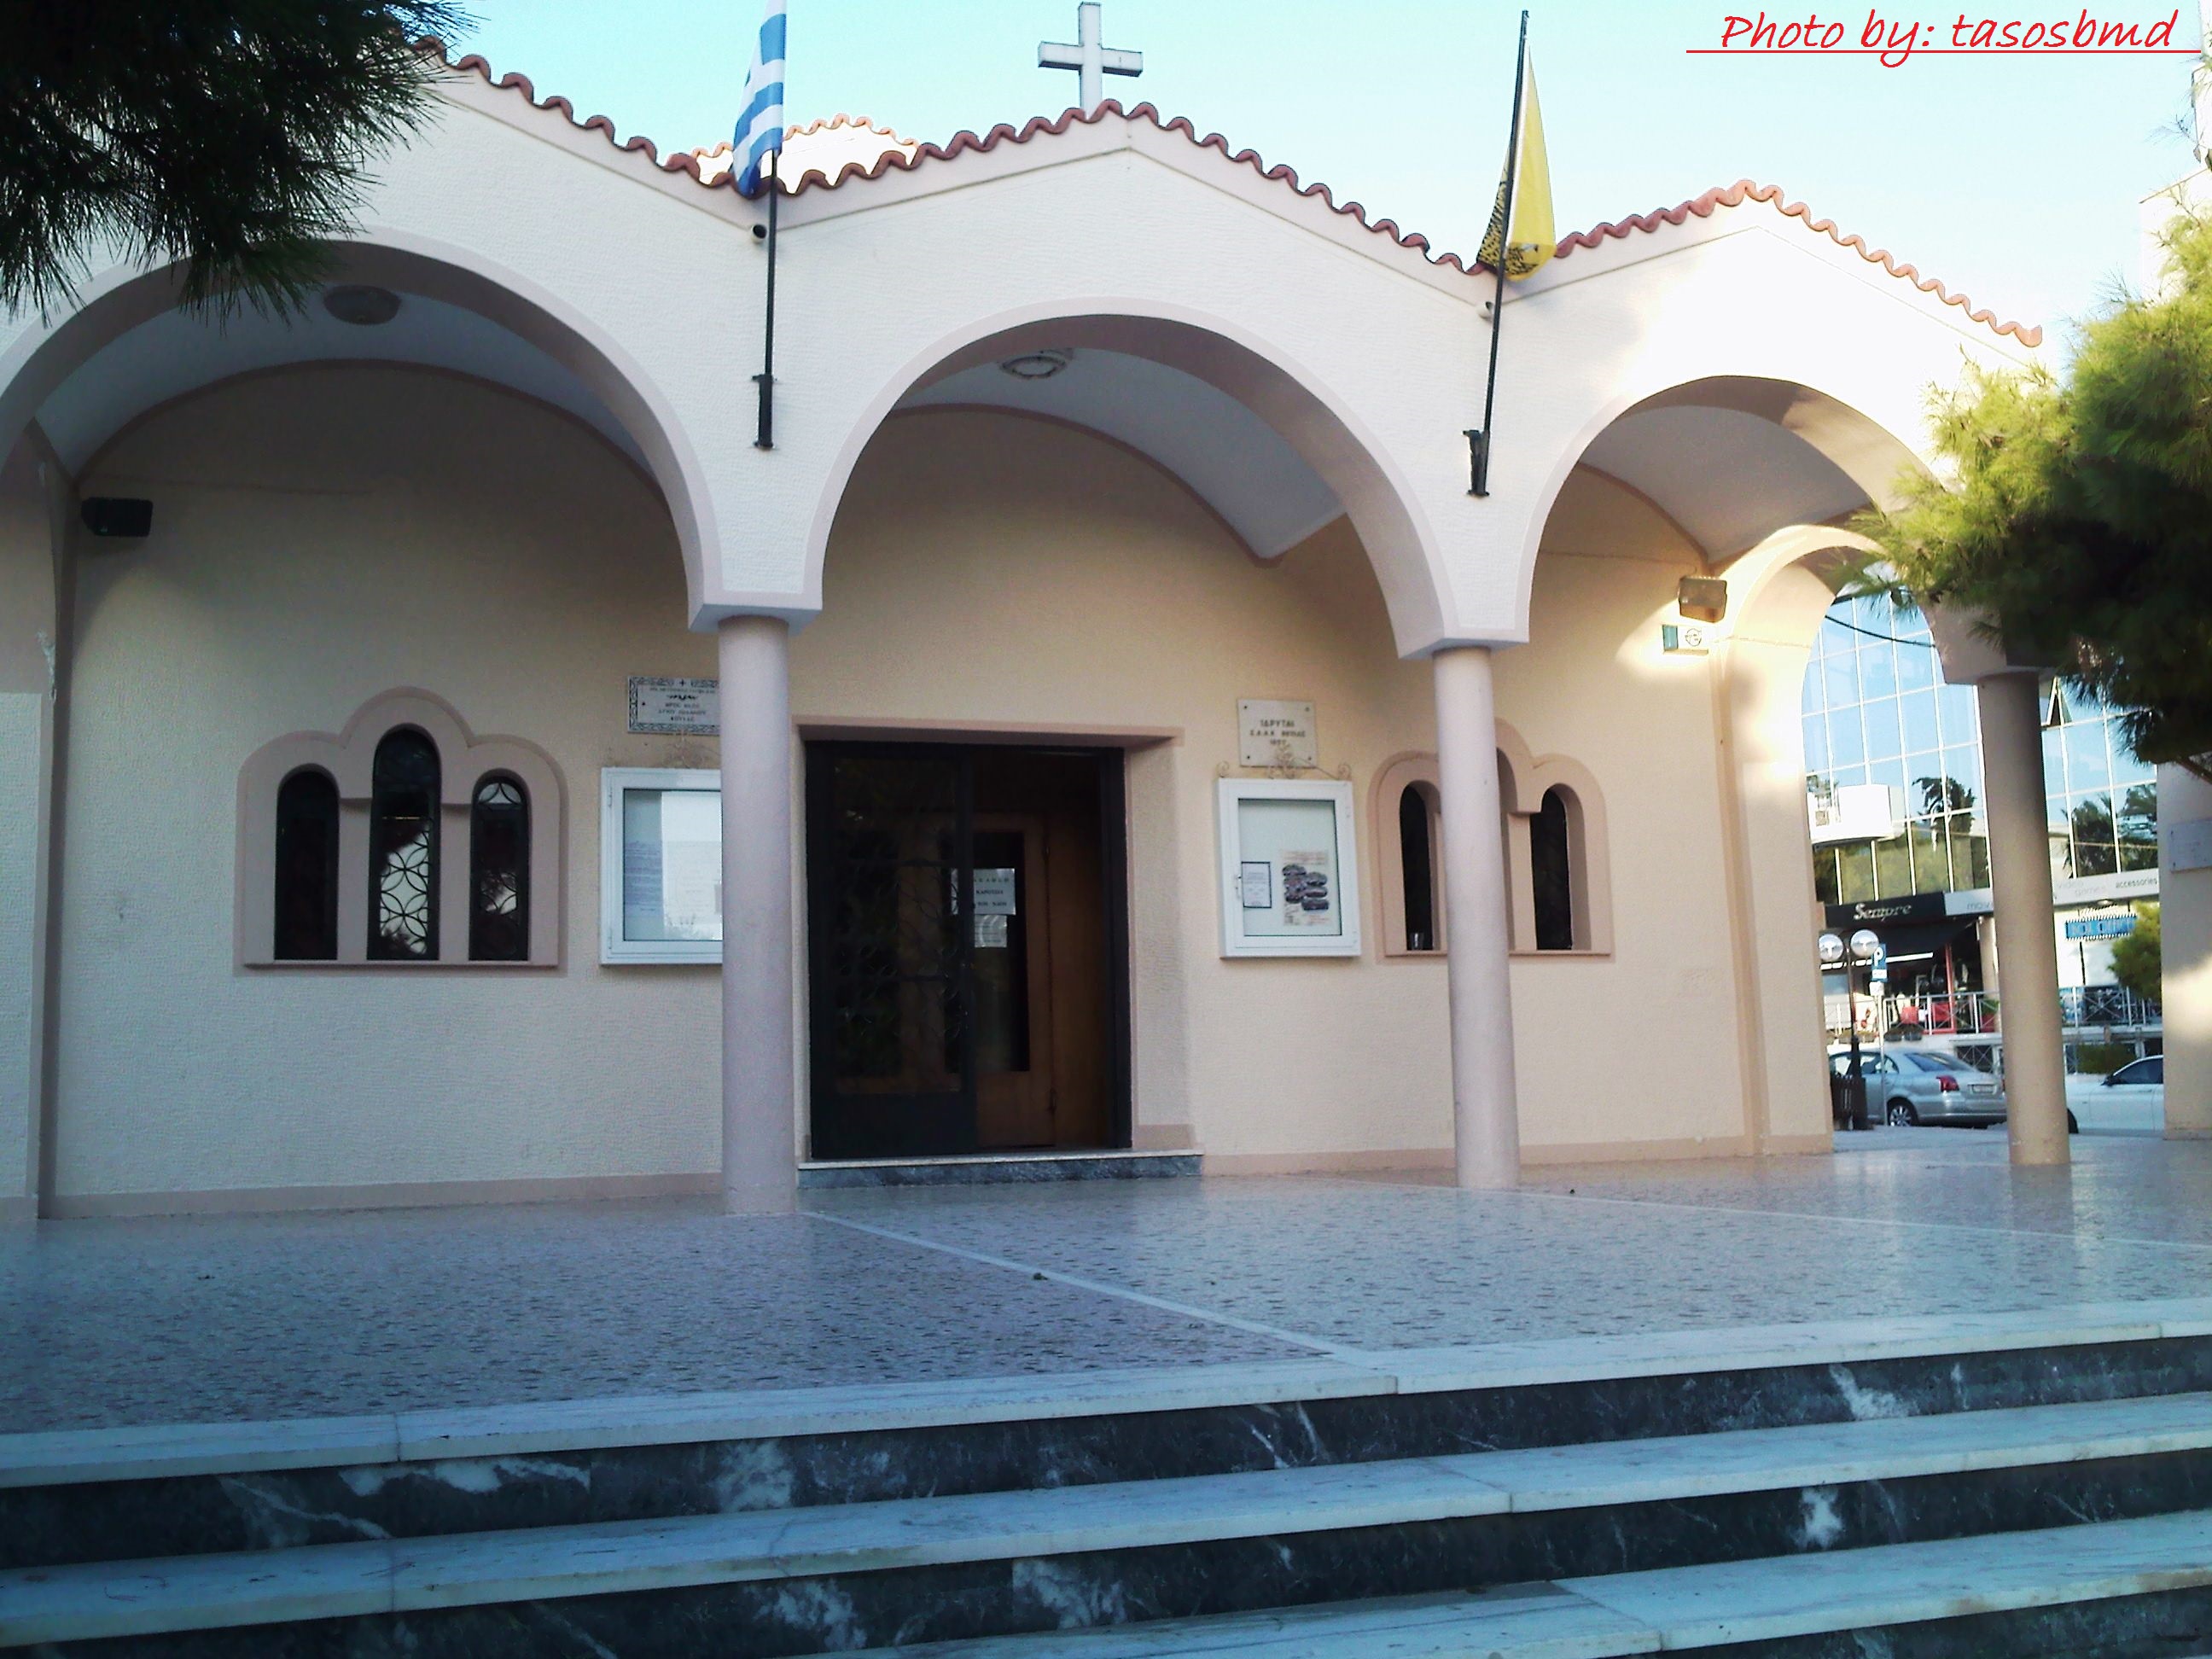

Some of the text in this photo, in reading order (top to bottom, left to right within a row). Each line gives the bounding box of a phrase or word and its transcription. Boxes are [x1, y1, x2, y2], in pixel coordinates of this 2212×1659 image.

[2116, 876, 2158, 889] accessories
[1853, 902, 1912, 923] Sempre
[1873, 946, 1884, 967] P
